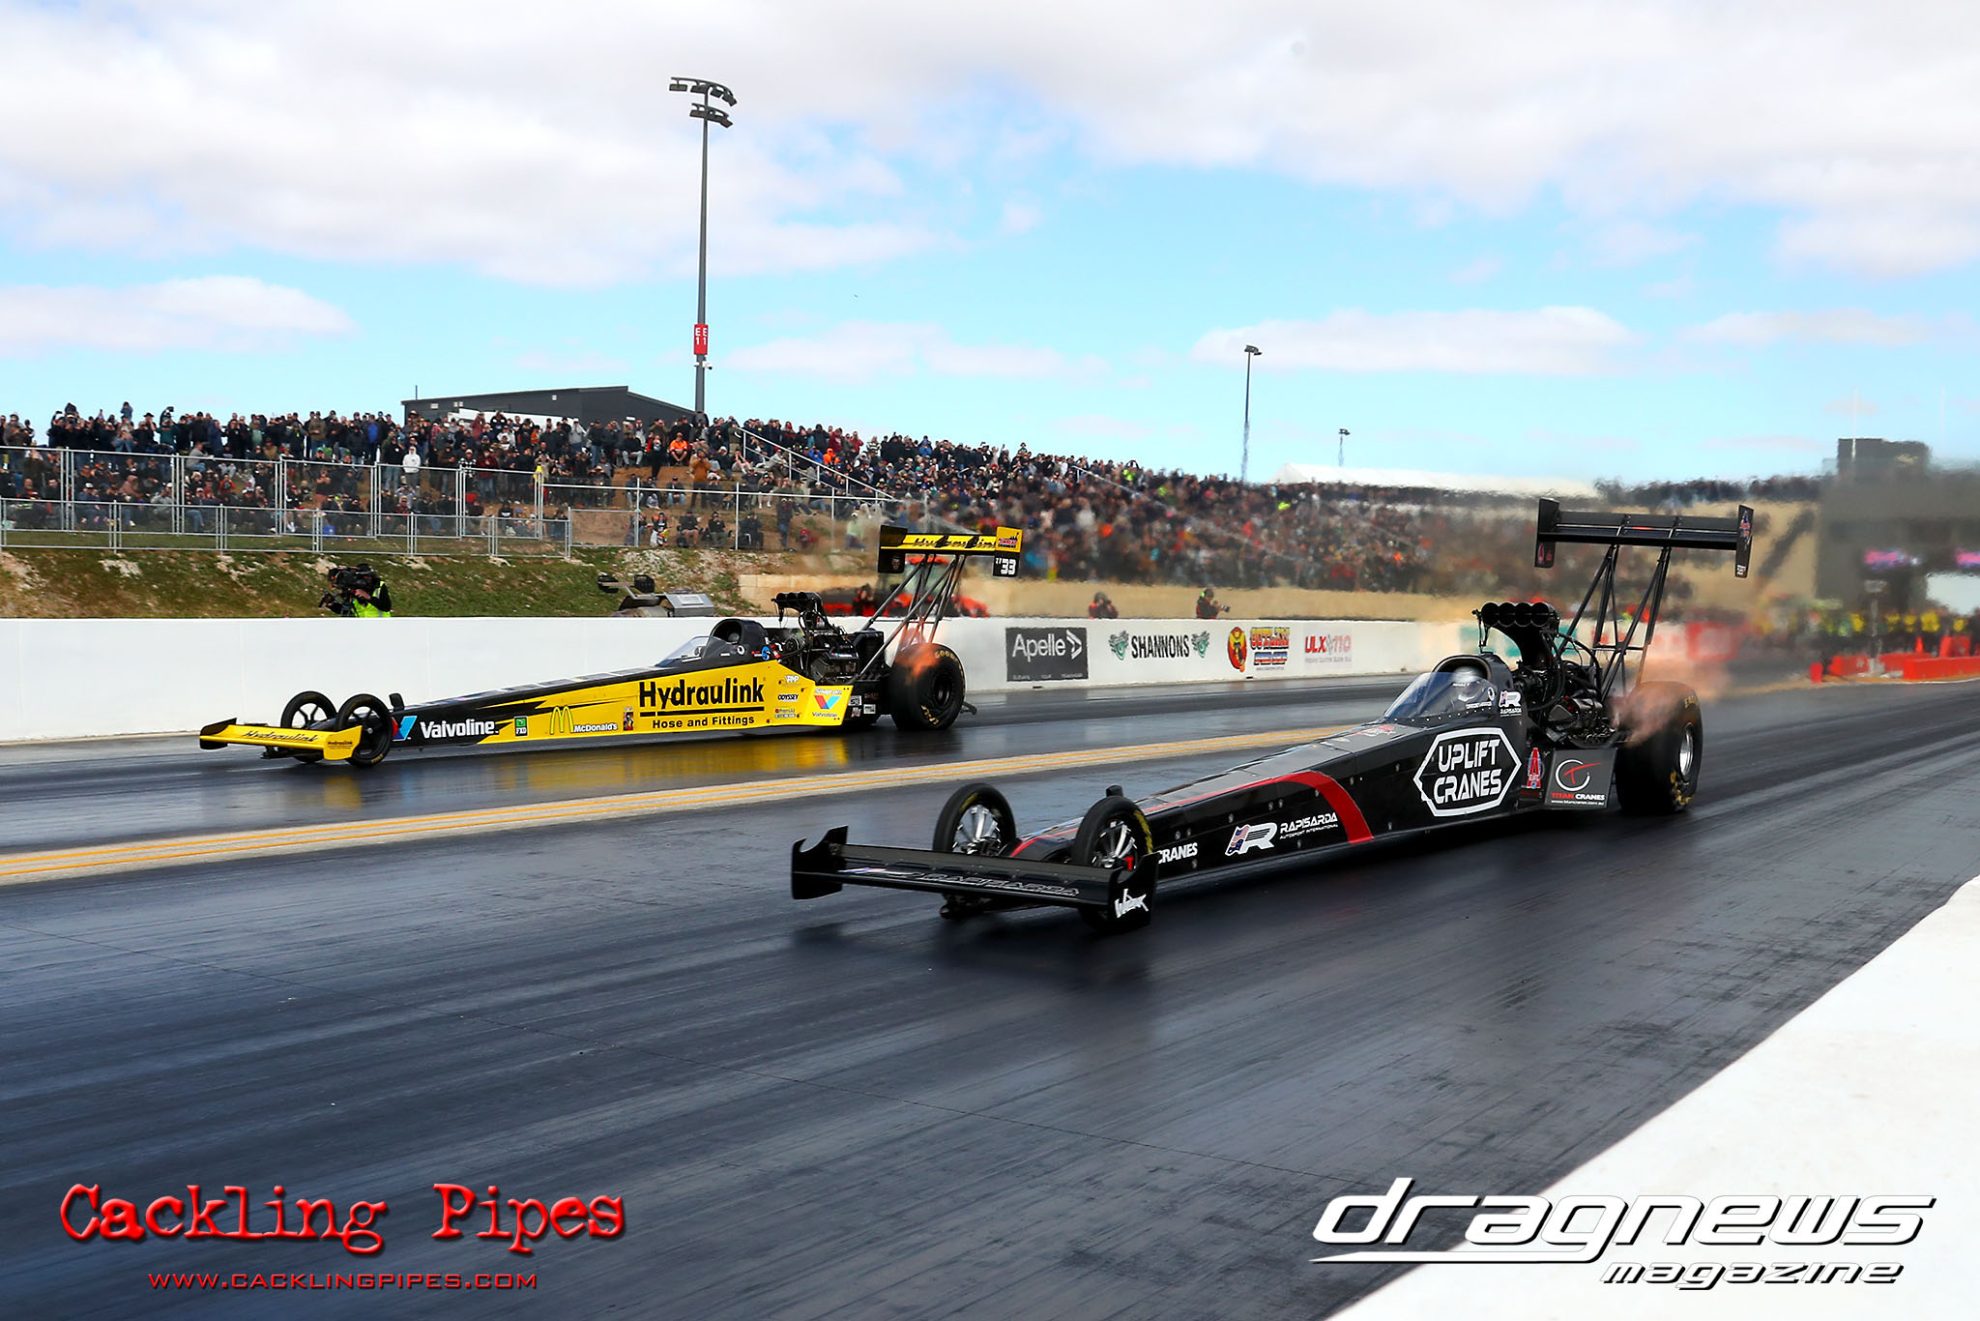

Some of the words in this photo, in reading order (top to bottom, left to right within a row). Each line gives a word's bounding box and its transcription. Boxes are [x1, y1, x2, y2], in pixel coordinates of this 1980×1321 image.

[1001, 558, 1016, 575] 33
[1012, 633, 1066, 662] Apelle
[1131, 634, 1190, 659] SHANNONS
[639, 677, 764, 709] Hydraulink
[419, 718, 496, 739] Valvoline
[573, 723, 618, 733] McDonald's
[652, 719, 683, 729] Hose
[687, 717, 708, 728] and
[712, 716, 755, 726] Fittings
[243, 730, 319, 743] Hydraulink
[1438, 739, 1501, 773] UPLIFT
[1433, 769, 1503, 804] CRANES
[1575, 793, 1606, 801] CRANES
[1280, 812, 1339, 834] RAPISARDA
